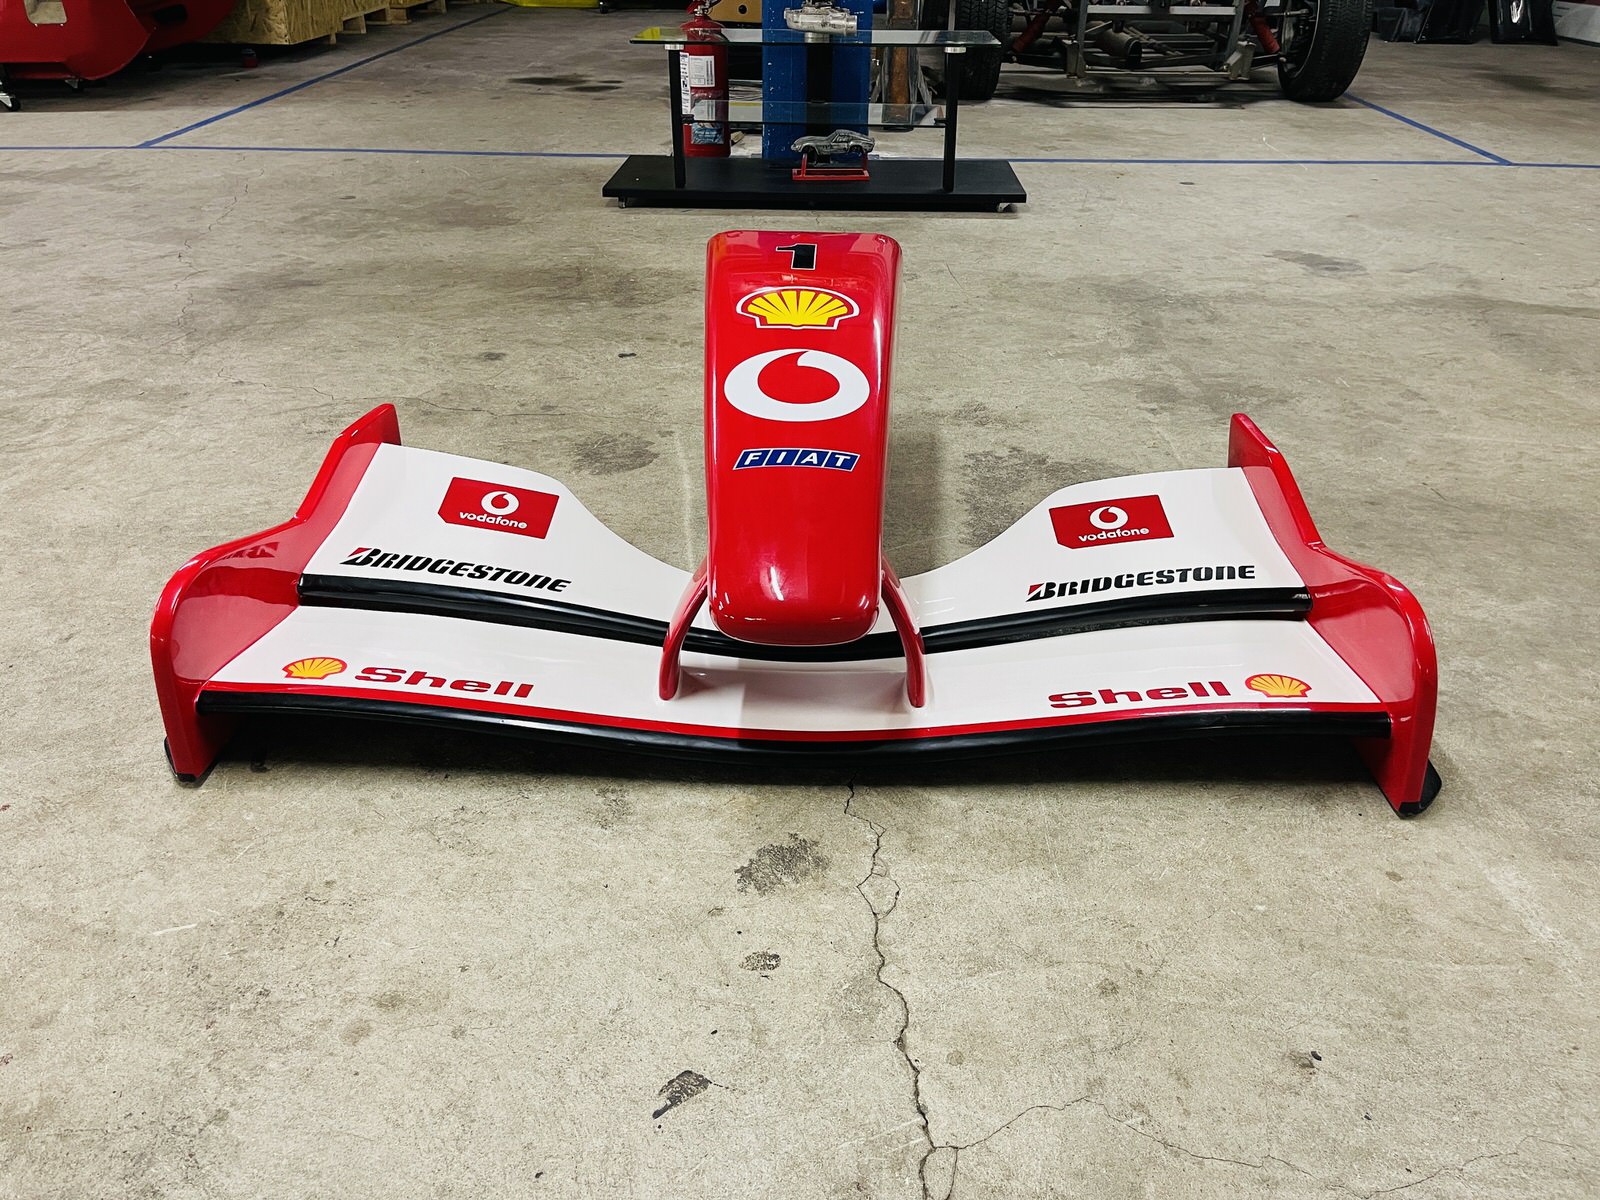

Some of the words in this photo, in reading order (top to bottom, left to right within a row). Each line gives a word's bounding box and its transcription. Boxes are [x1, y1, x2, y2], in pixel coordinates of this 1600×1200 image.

[776, 243, 817, 270] 1
[742, 450, 853, 468] FIAT
[459, 511, 527, 529] vodafone
[1078, 527, 1150, 542] vodafone
[340, 547, 572, 593] BRIDGESTONE
[1025, 565, 1255, 602] BRIDGESTONE
[354, 666, 534, 698] Shell
[1048, 681, 1231, 709] Shell
